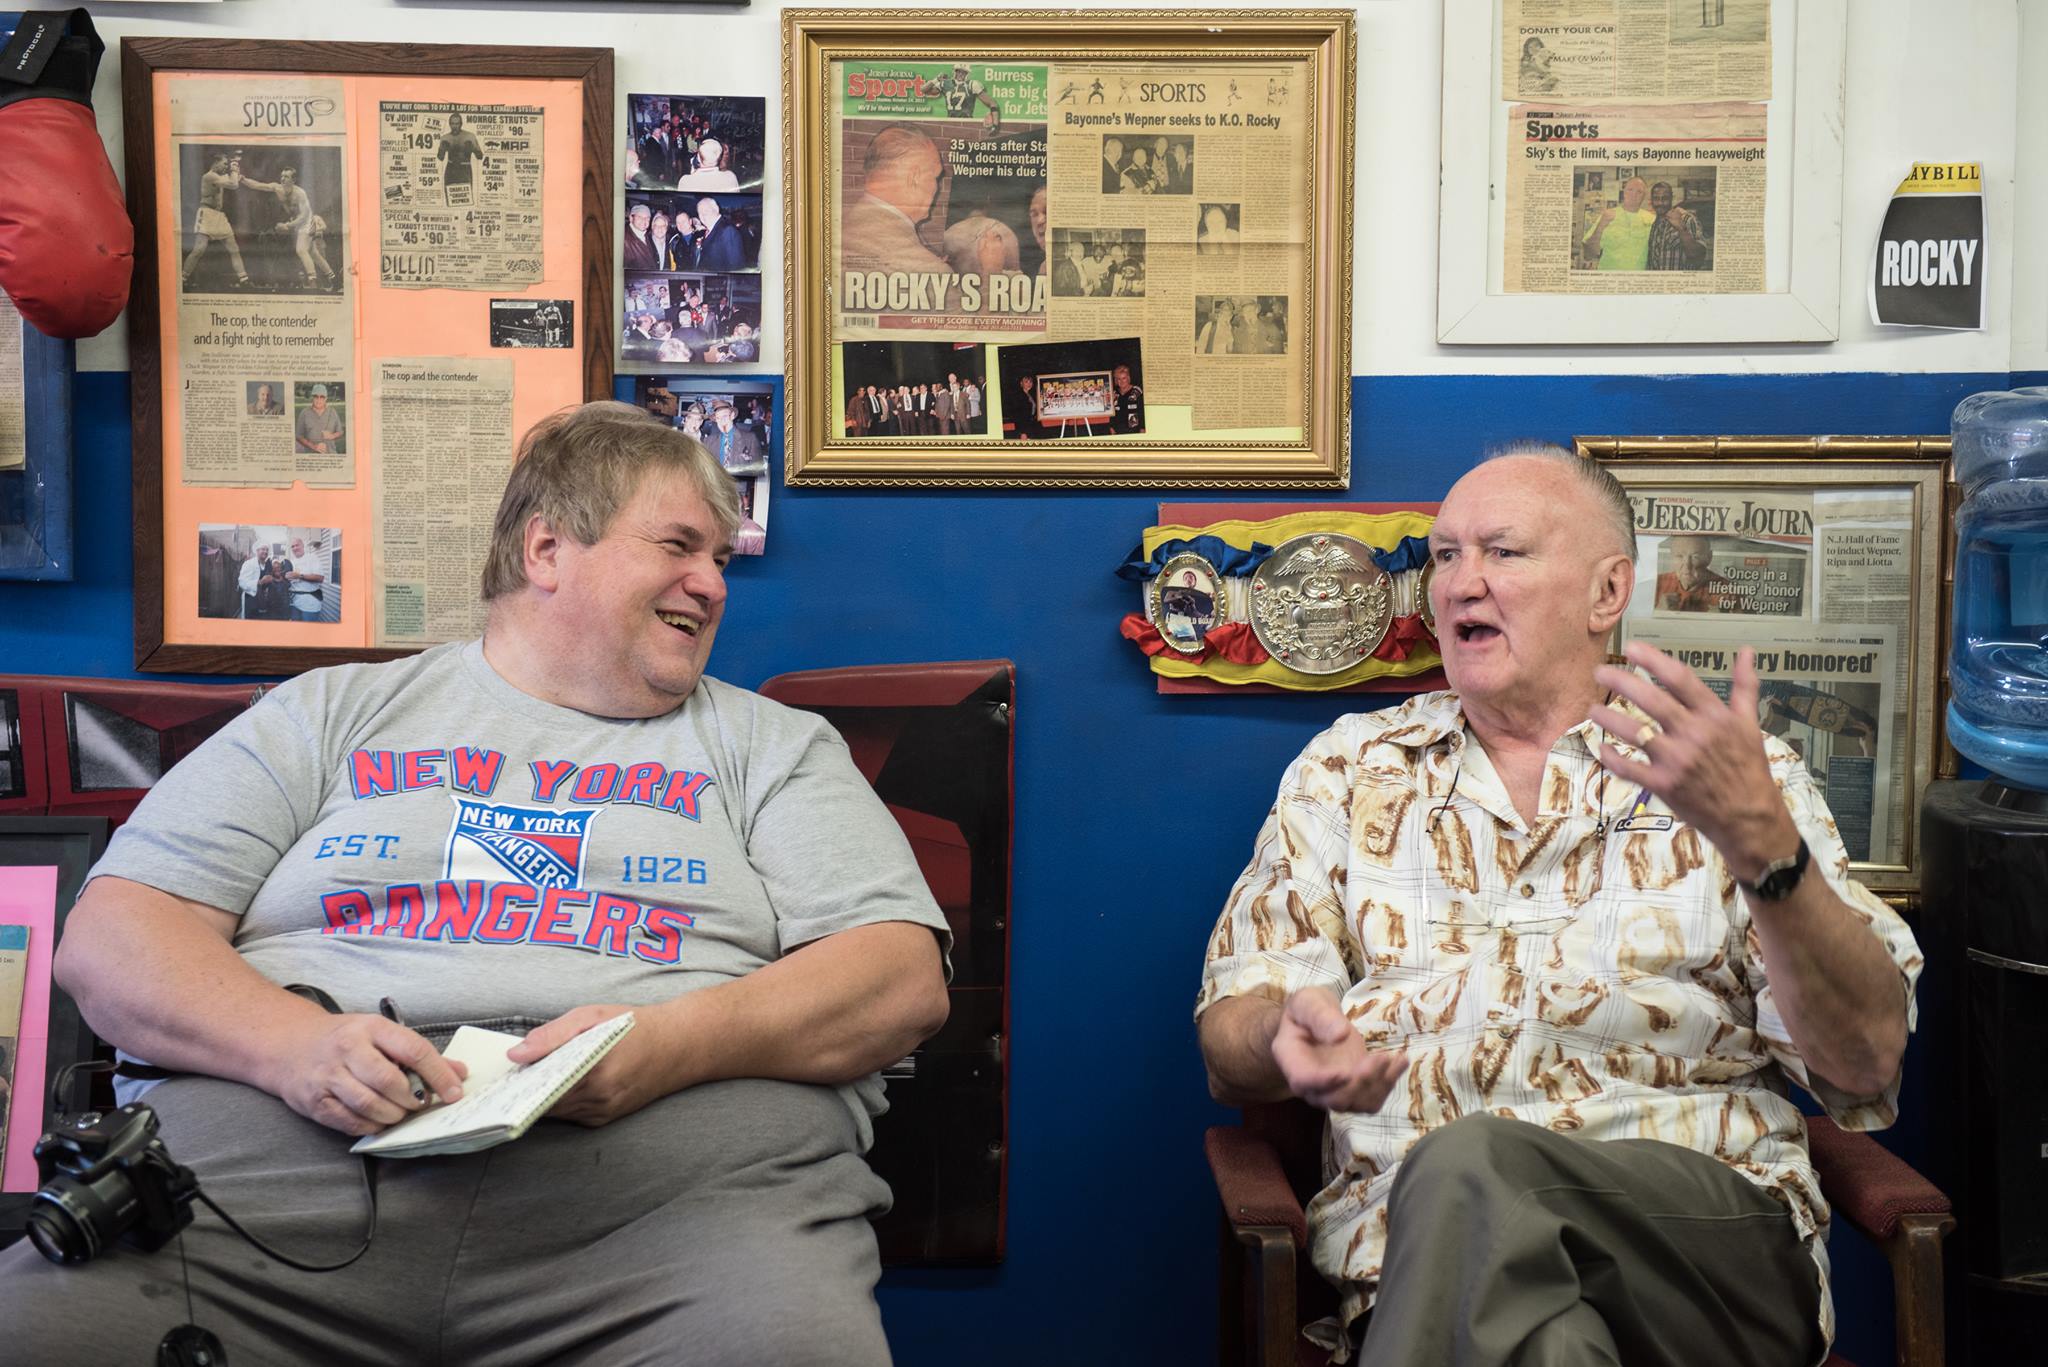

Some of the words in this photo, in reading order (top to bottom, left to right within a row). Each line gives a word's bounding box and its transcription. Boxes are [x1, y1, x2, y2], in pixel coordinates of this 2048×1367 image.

[984, 68, 1034, 82] Burress
[848, 72, 940, 101] Sport
[992, 86, 1015, 98] has
[1019, 85, 1040, 102] big
[1140, 82, 1206, 103] SPORTS
[243, 101, 314, 127] SPORTS
[1004, 102, 1022, 114] for
[385, 113, 395, 122] CV
[397, 114, 418, 122] JOINT
[466, 115, 497, 124] MONROE
[499, 116, 529, 124] STRUTS
[1065, 112, 1121, 130] Bayonne's
[1124, 112, 1166, 130] Wepner
[1169, 113, 1201, 126] seeks
[1205, 114, 1216, 126] to
[1219, 114, 1243, 127] K.O.
[1246, 114, 1280, 129] Rocky
[1526, 120, 1599, 142] Sports
[950, 140, 965, 150] 35
[968, 141, 997, 154] years
[1000, 140, 1027, 151] after
[1526, 147, 1555, 161] Sky's
[1559, 147, 1577, 159] the
[1581, 147, 1610, 160] limit,
[1614, 149, 1639, 161] says
[1643, 148, 1691, 161] Bayonne
[1695, 147, 1765, 162] heavyweight
[482, 156, 490, 169] 4
[948, 152, 973, 164] film,
[976, 153, 1047, 168] documentary
[953, 165, 994, 178] Wepner
[997, 165, 1013, 177] his
[1016, 165, 1036, 177] due
[466, 211, 474, 223] 4
[394, 222, 421, 230] EXHAUST
[422, 223, 451, 231] SYSTEMS
[1882, 239, 1978, 286] ROCKY
[845, 271, 981, 313] ROCKY'S
[211, 313, 229, 327] The
[230, 315, 250, 329] cop,
[251, 313, 267, 327] the
[269, 314, 318, 328] contender
[946, 317, 973, 325] SCORE
[975, 318, 1001, 326] EVERY
[1002, 318, 1046, 327] MORNING!
[194, 332, 212, 345] and
[214, 335, 220, 345] a
[222, 332, 244, 347] fight
[246, 332, 270, 348] night
[272, 334, 283, 346] to
[284, 334, 335, 347] remember
[382, 370, 396, 381] The
[397, 372, 411, 382] cop
[412, 371, 426, 381] and
[427, 371, 440, 381] the
[441, 372, 479, 382] contender
[1637, 497, 1731, 532] JERSEY
[1846, 535, 1864, 544] Hall
[1865, 535, 1874, 544] of
[1876, 535, 1900, 544] Fame
[1826, 547, 1835, 555] to
[1837, 546, 1865, 555] induct
[1867, 547, 1901, 557] Wepner,
[1827, 558, 1847, 568] Ripa
[1848, 558, 1865, 566] and
[1867, 558, 1893, 566] Liotta
[1724, 567, 1760, 580] 'Once
[1763, 567, 1775, 581] in
[1780, 571, 1787, 581] a
[1709, 581, 1760, 595] lifetime'
[1764, 583, 1801, 597] honor
[1719, 596, 1736, 609] for
[1740, 598, 1789, 613] Wepner
[1783, 650, 1878, 674] honored'
[347, 746, 507, 800] NEW
[529, 758, 717, 823] YORK
[462, 806, 515, 830] NEW
[522, 817, 582, 833] YORK
[314, 834, 400, 860] EST.
[475, 831, 570, 889] RANGERS
[622, 855, 707, 885] 1926
[320, 879, 696, 965] RANGERS
